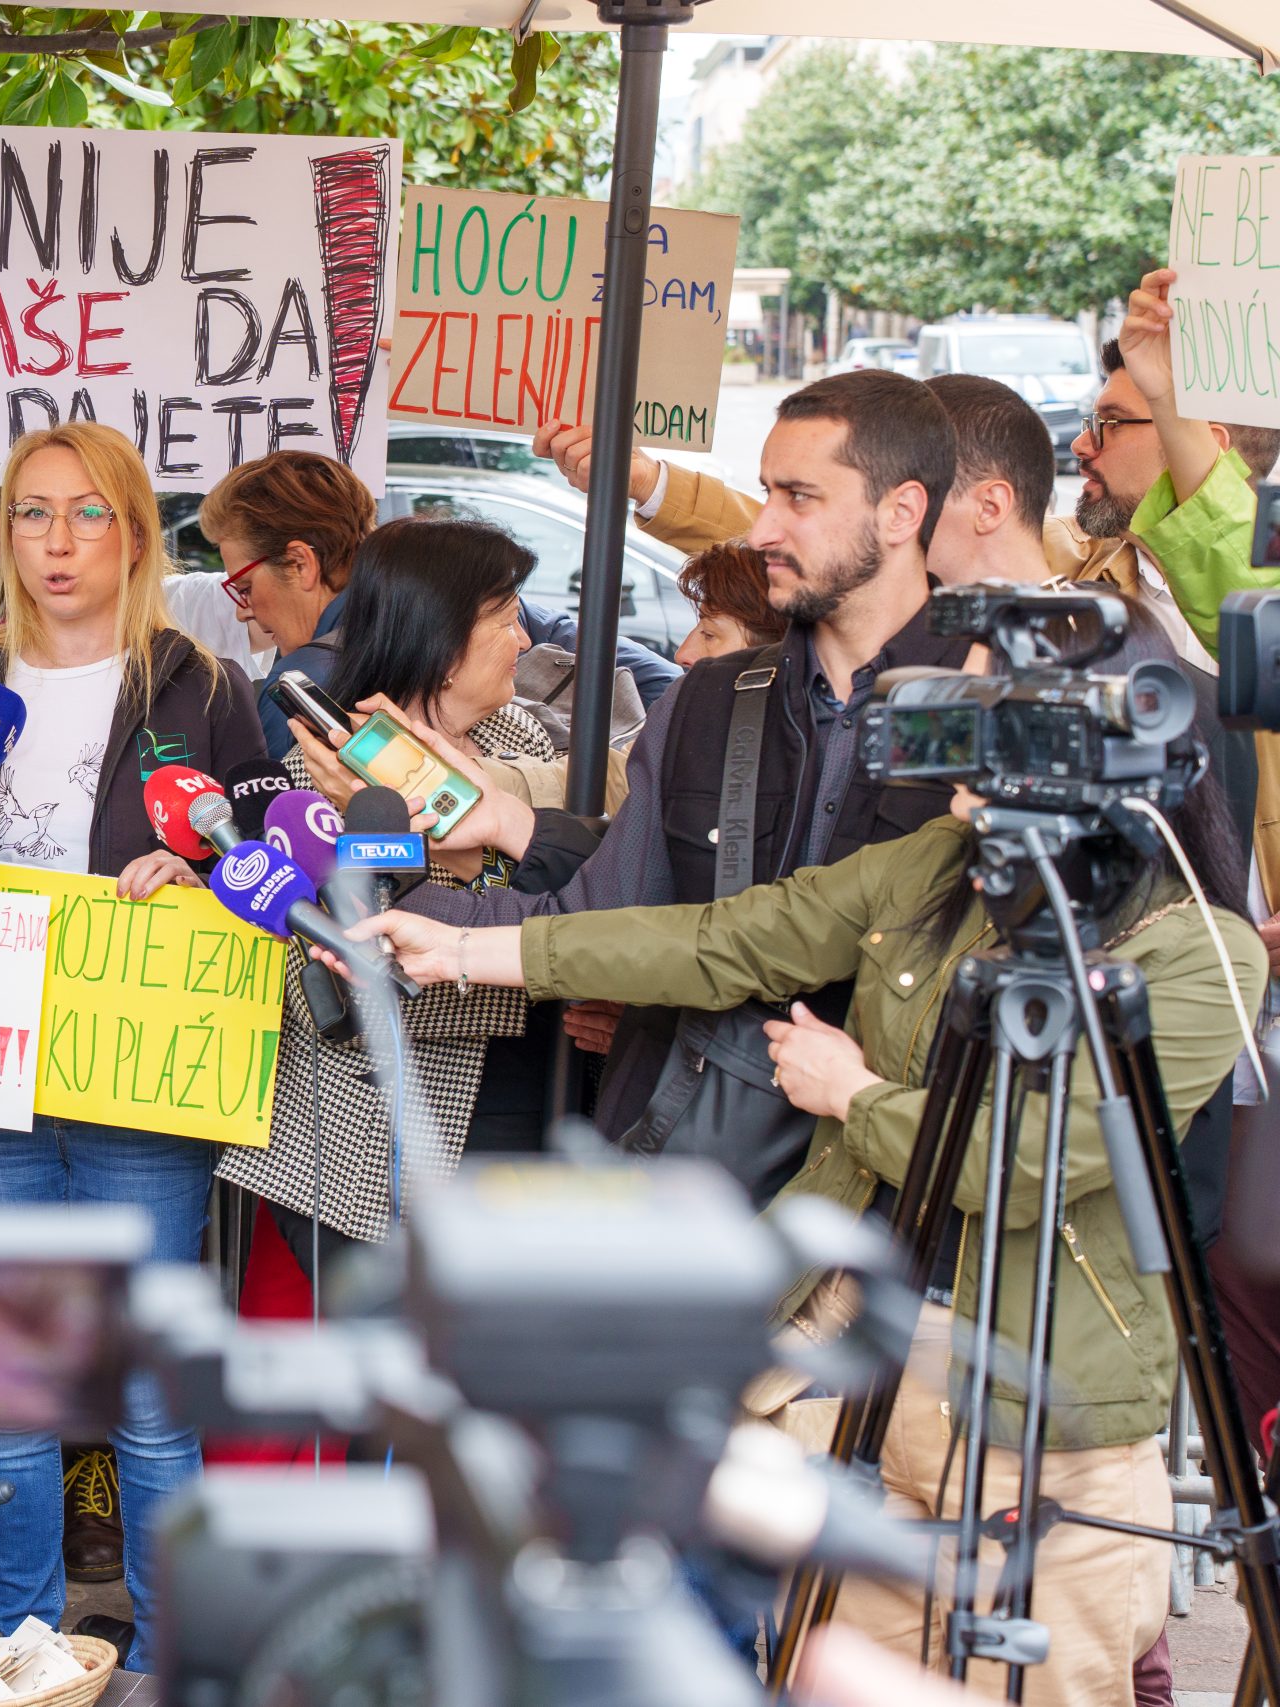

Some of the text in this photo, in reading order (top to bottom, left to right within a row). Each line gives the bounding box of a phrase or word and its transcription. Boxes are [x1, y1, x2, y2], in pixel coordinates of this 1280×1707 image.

[1175, 166, 1222, 265] NE
[412, 199, 577, 302] HOĆU
[592, 273, 721, 325] ZDAM,
[194, 277, 323, 387] DA
[632, 400, 708, 444] KIDAM
[232, 776, 292, 800] RTCG
[721, 725, 756, 880] Calvin Klein
[356, 844, 408, 858] TEUTA
[250, 864, 295, 912] GRADSKA
[260, 873, 297, 912] RADIO TELEVIZIJA
[183, 929, 289, 1006] IZDATI
[113, 1011, 280, 1122] PLAŽU!
